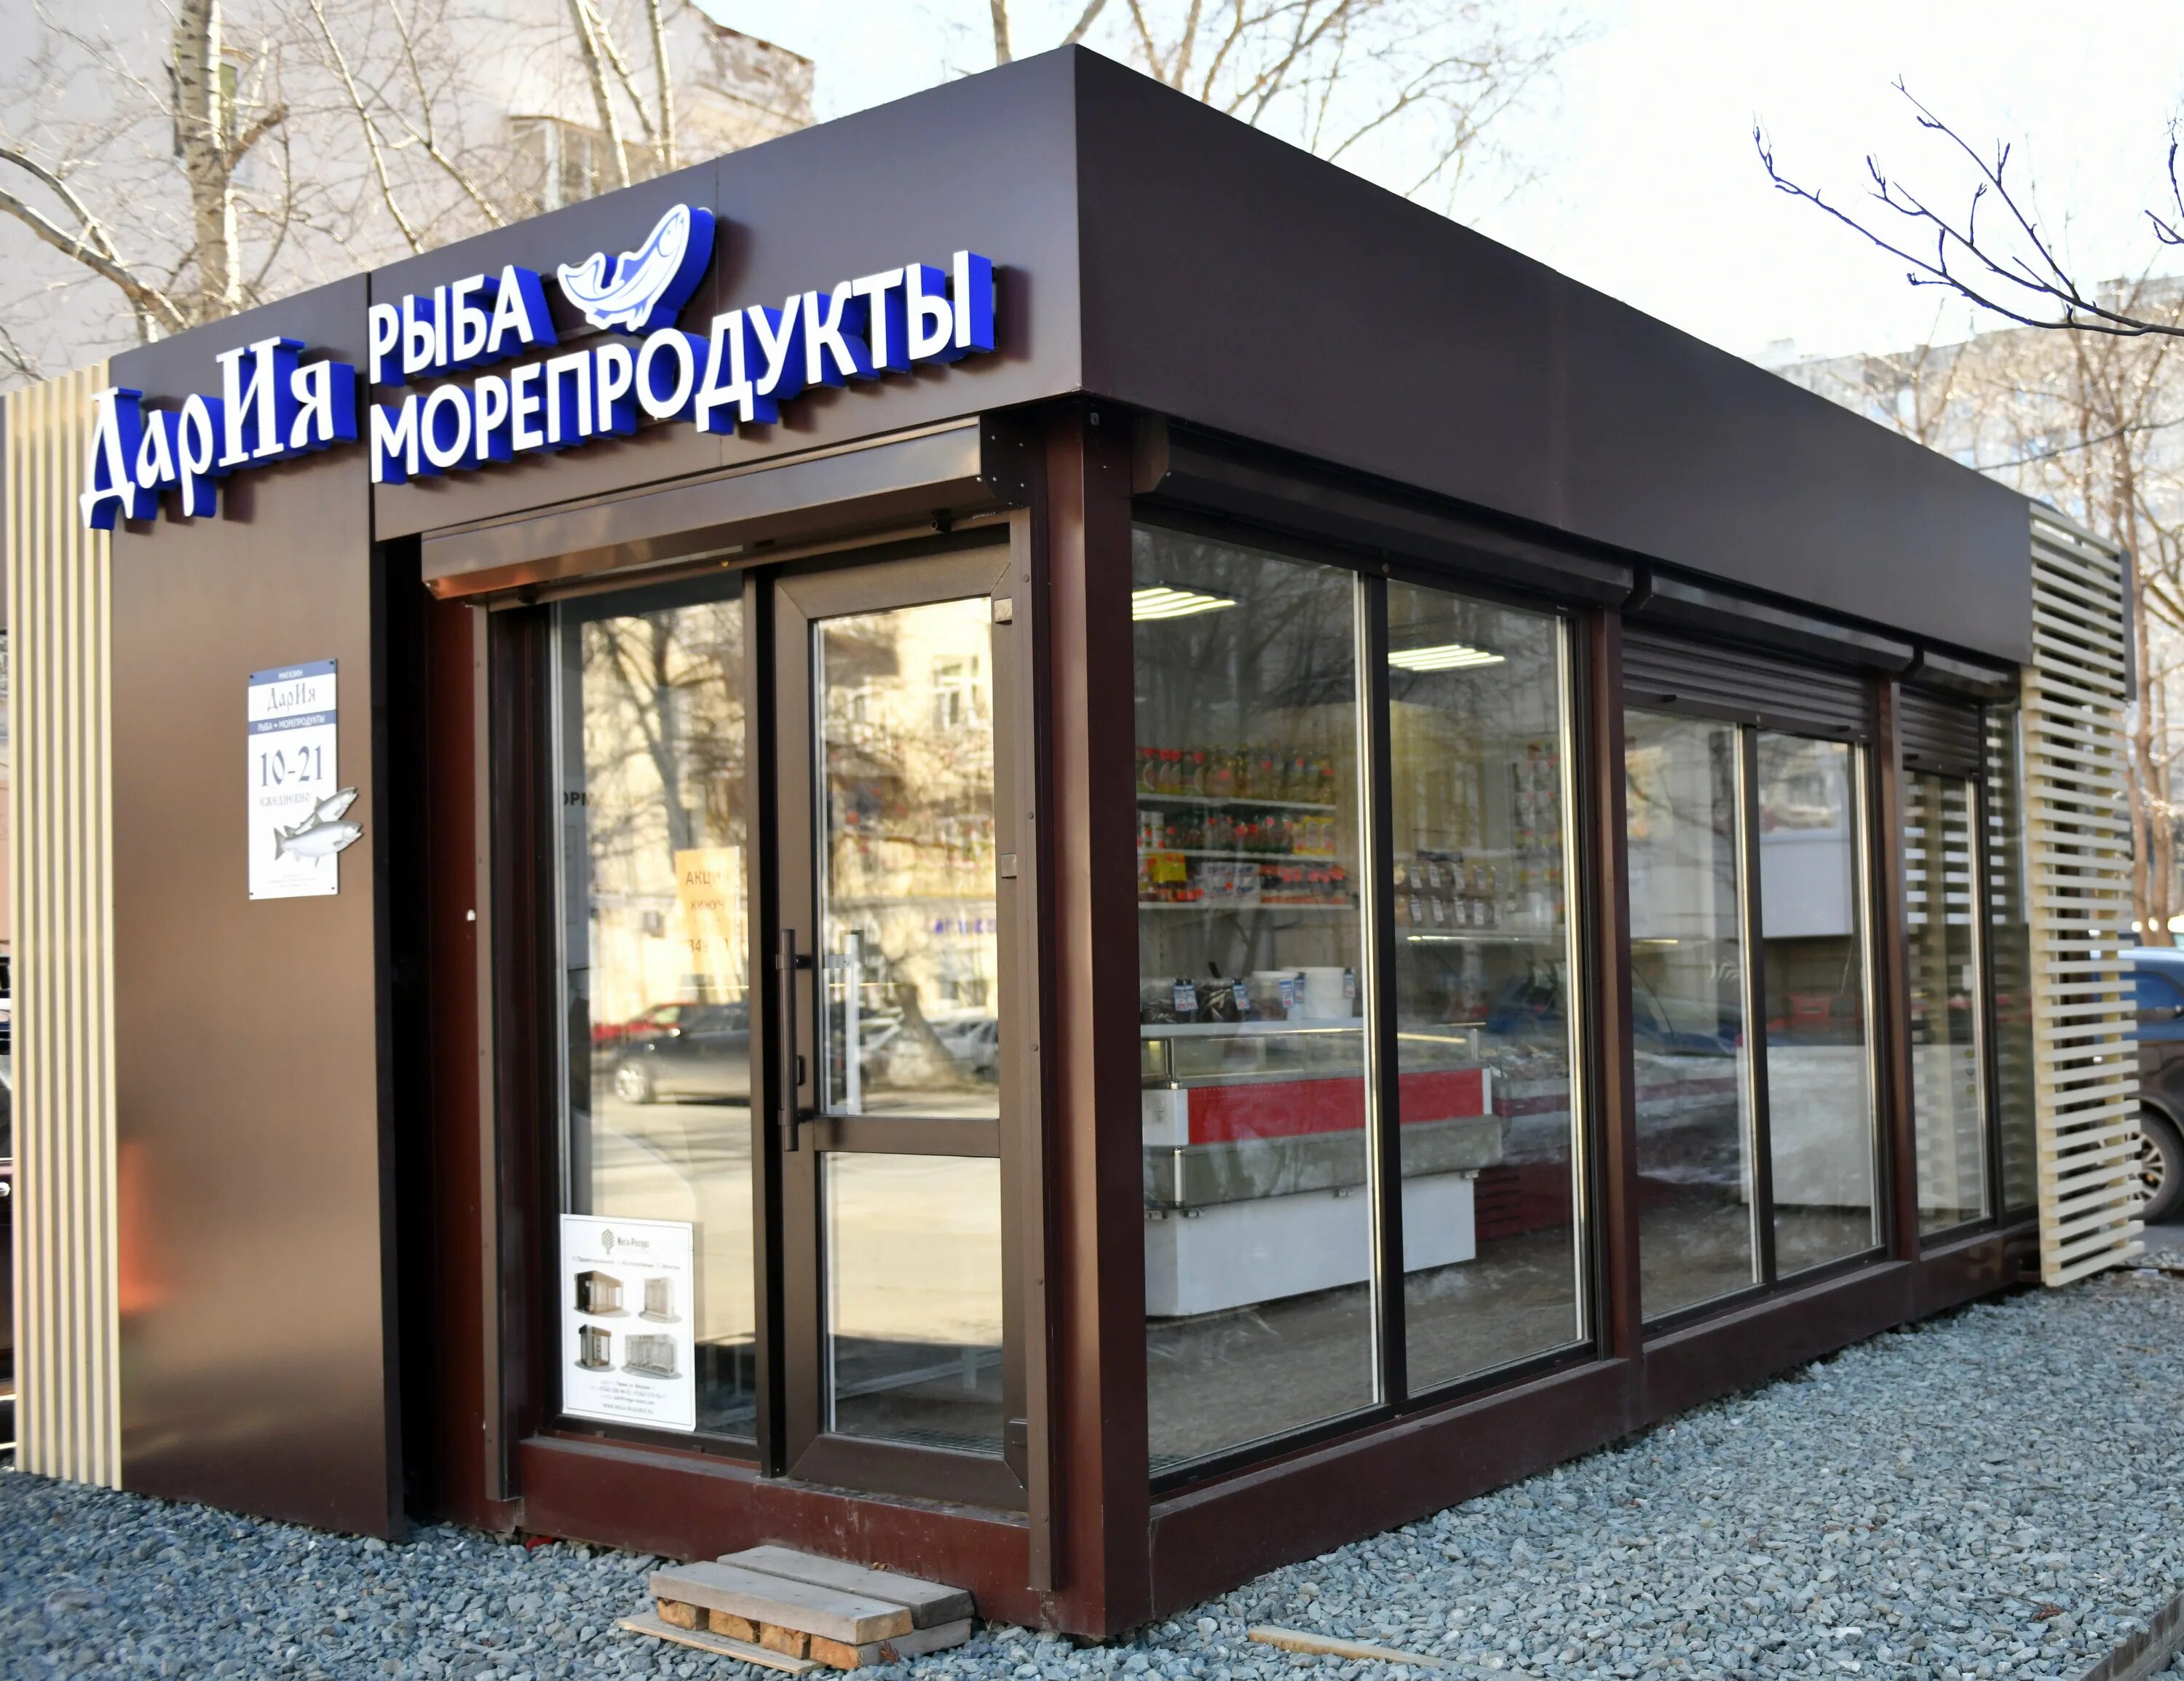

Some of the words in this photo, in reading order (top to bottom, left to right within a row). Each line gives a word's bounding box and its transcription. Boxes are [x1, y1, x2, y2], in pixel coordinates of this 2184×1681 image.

[368, 264, 534, 384] РЫБА
[370, 250, 972, 483] МОРЕПРОДУКТЫ
[79, 336, 334, 529] ДарИя
[279, 669, 303, 679] МАГАЗИН
[267, 683, 316, 713] ДарИя
[258, 722, 272, 732] РЫБА
[279, 715, 325, 729] МОРЕПРОДУКТЫ
[261, 745, 323, 787] 10-21
